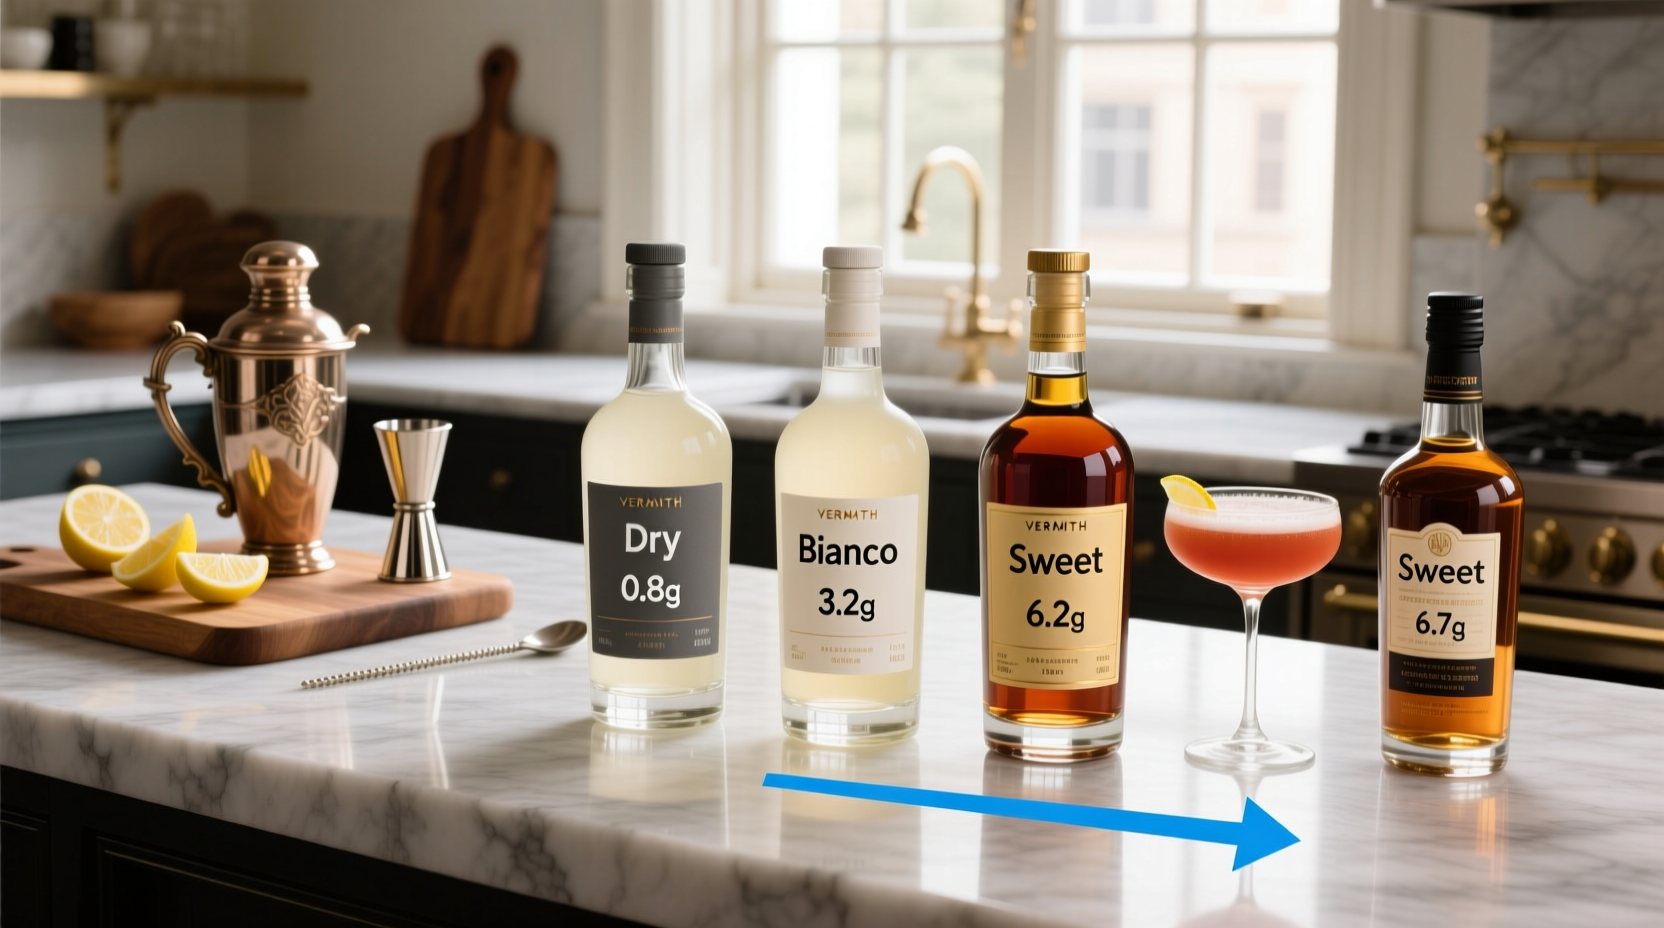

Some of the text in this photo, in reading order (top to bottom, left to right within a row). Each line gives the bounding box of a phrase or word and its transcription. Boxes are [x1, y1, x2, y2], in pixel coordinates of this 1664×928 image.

[625, 522, 682, 562] Dry
[799, 533, 898, 566] Bianco
[1009, 543, 1103, 575] Sweet
[1398, 553, 1485, 584] Sweet
[621, 574, 681, 609] 0.8g
[818, 587, 875, 622] 3.2g
[1026, 599, 1085, 633] 6.2g
[1415, 610, 1466, 642] 6.7g
